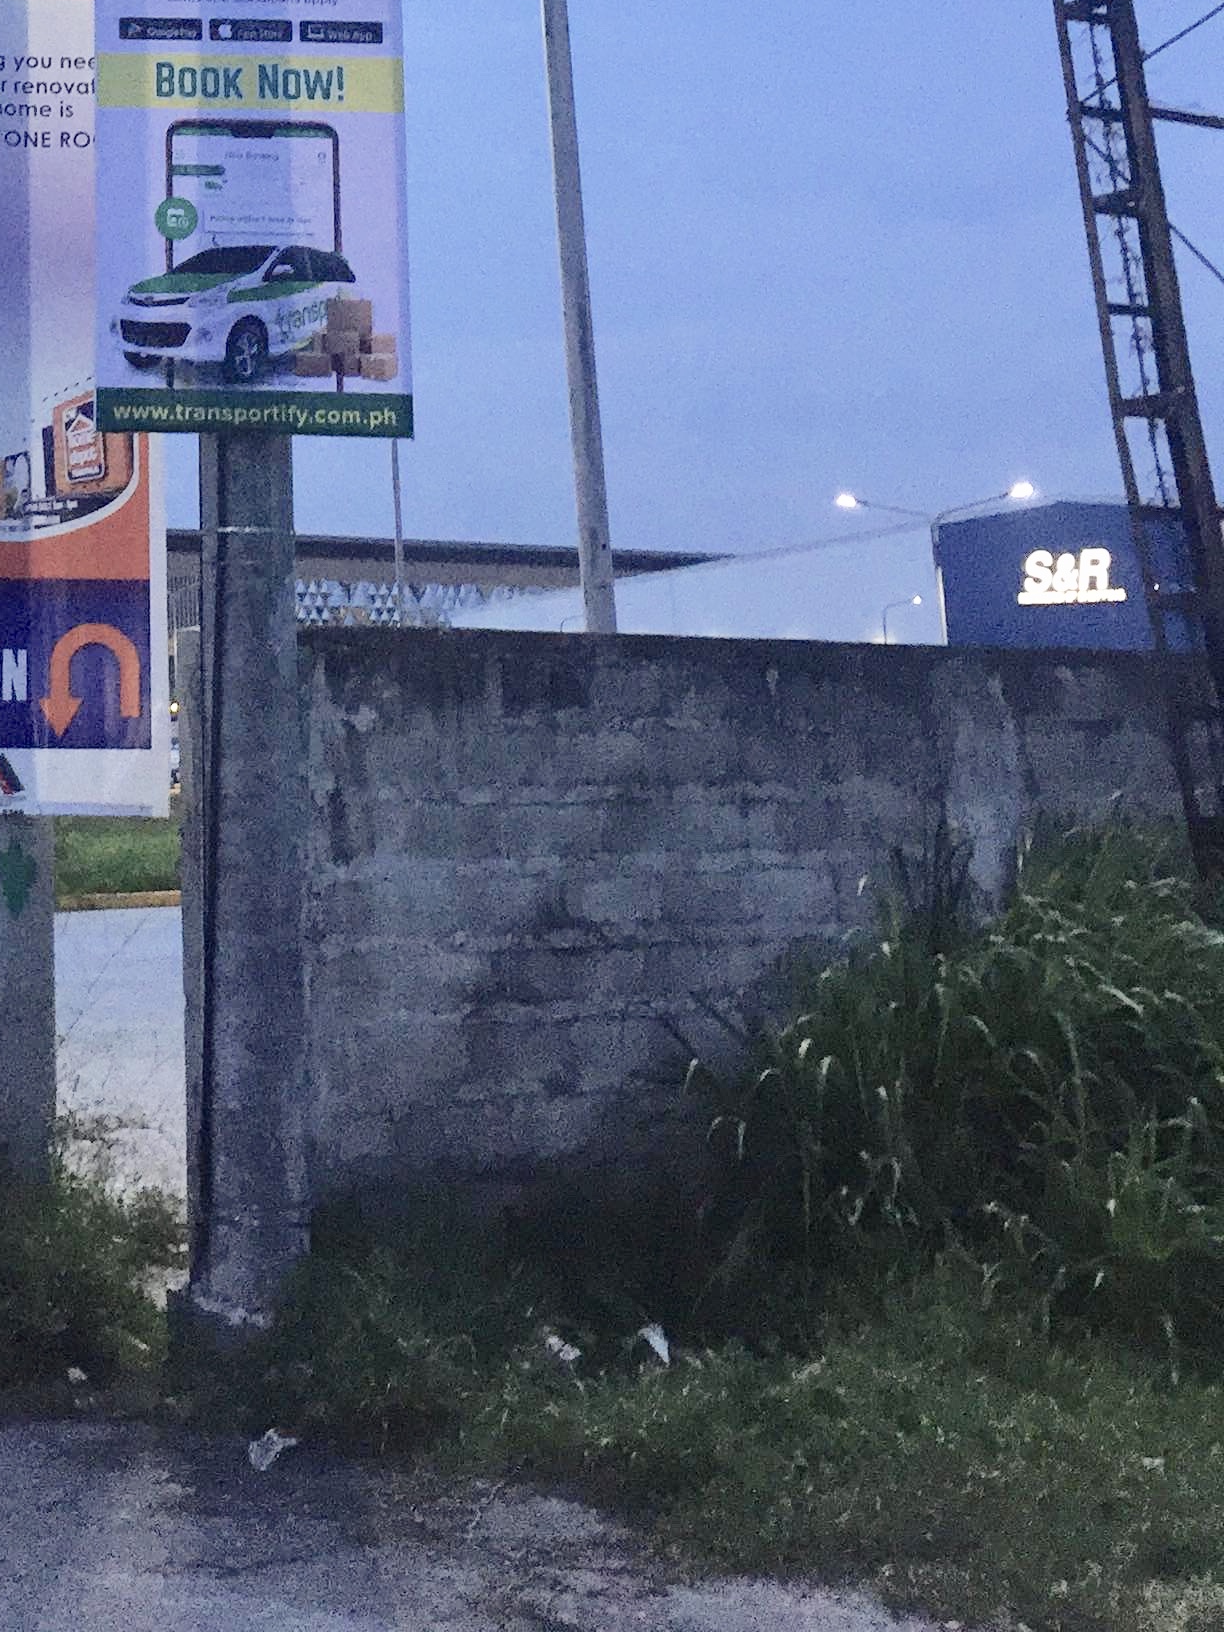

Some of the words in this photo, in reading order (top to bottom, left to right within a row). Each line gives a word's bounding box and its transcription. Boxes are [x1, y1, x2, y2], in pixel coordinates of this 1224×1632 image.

[14, 55, 52, 72] you
[154, 62, 243, 100] BOOK
[258, 63, 347, 101] NOW!
[60, 100, 74, 118] is
[4, 129, 51, 148] ONE
[60, 131, 95, 148] RO
[112, 403, 398, 428] www.transportify.com.ph
[1024, 547, 1112, 593] S&R
